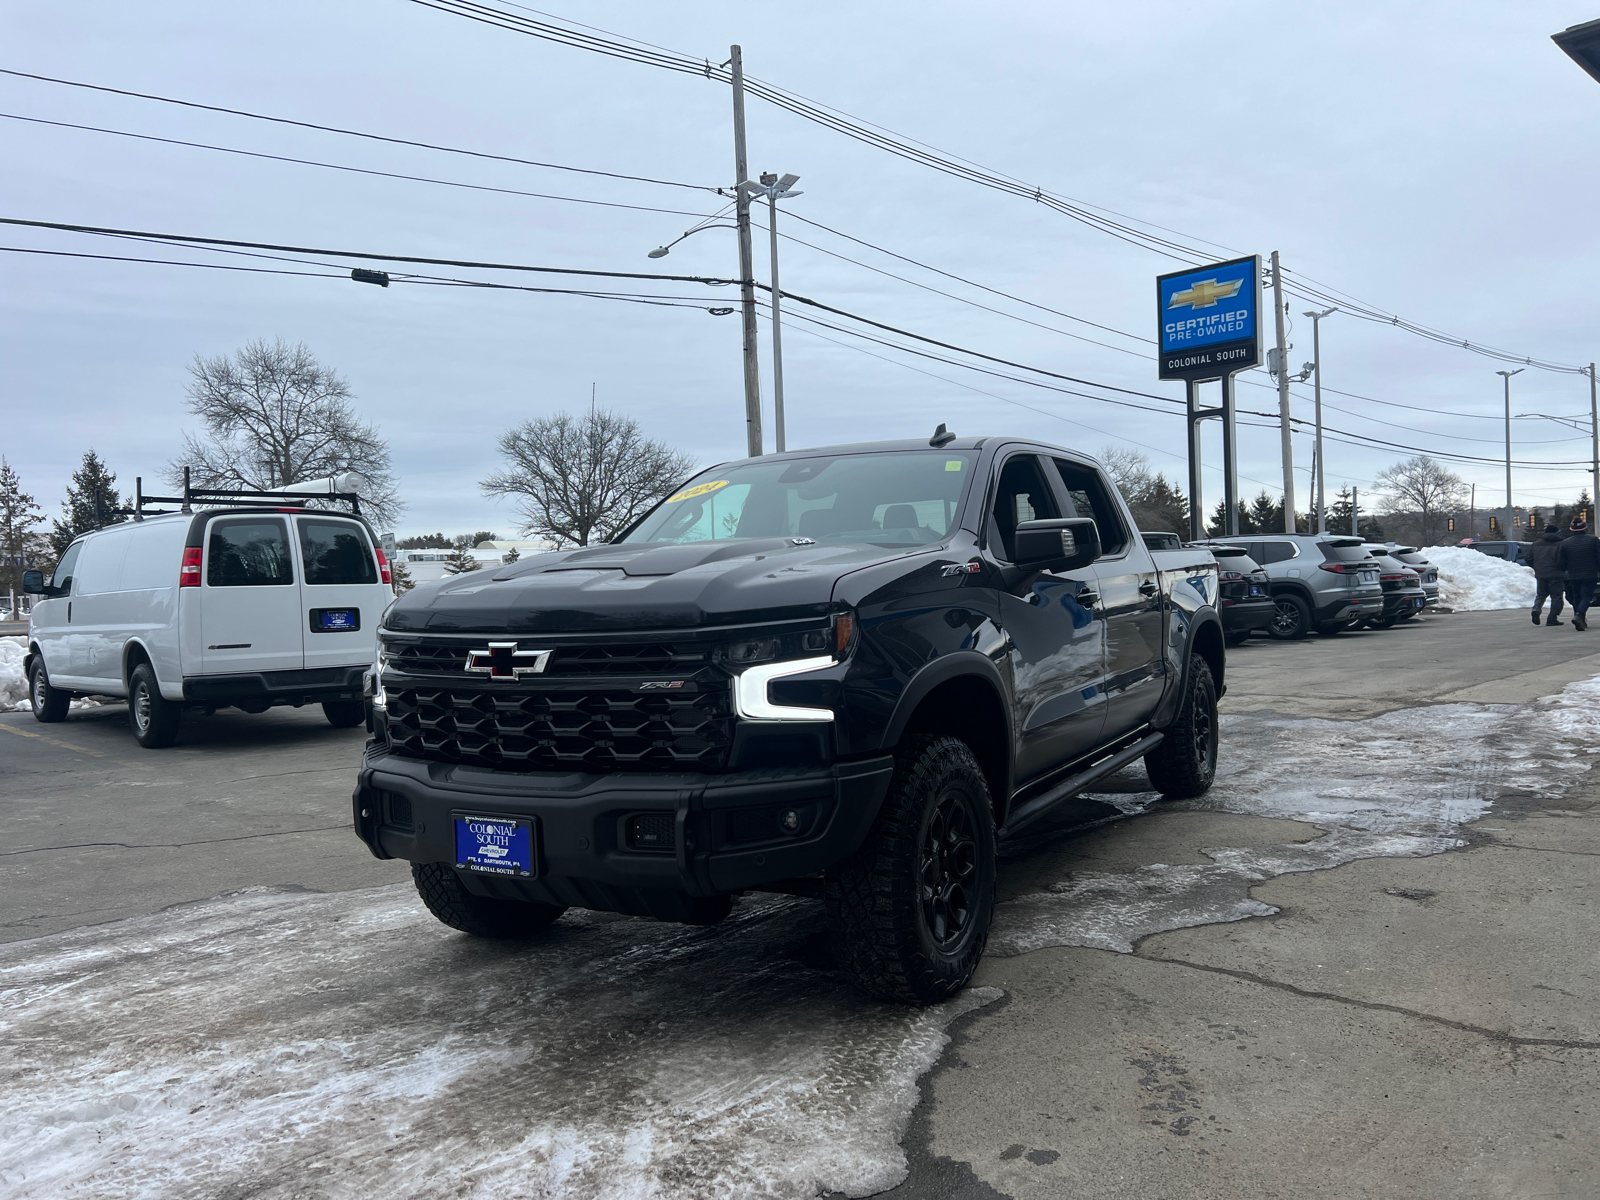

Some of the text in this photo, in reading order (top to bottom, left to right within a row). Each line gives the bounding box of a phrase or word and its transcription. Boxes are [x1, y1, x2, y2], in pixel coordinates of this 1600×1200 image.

[1165, 309, 1248, 333] CERTIFIED
[1169, 320, 1244, 342] PRE-OWNED
[1168, 348, 1246, 369] COLONIAL SOUTH
[940, 562, 980, 577] ZR2
[639, 680, 684, 690] ZR2
[469, 823, 516, 836] COLONIAL
[476, 833, 509, 846] SOUTH
[470, 864, 496, 872] COLONIAL
